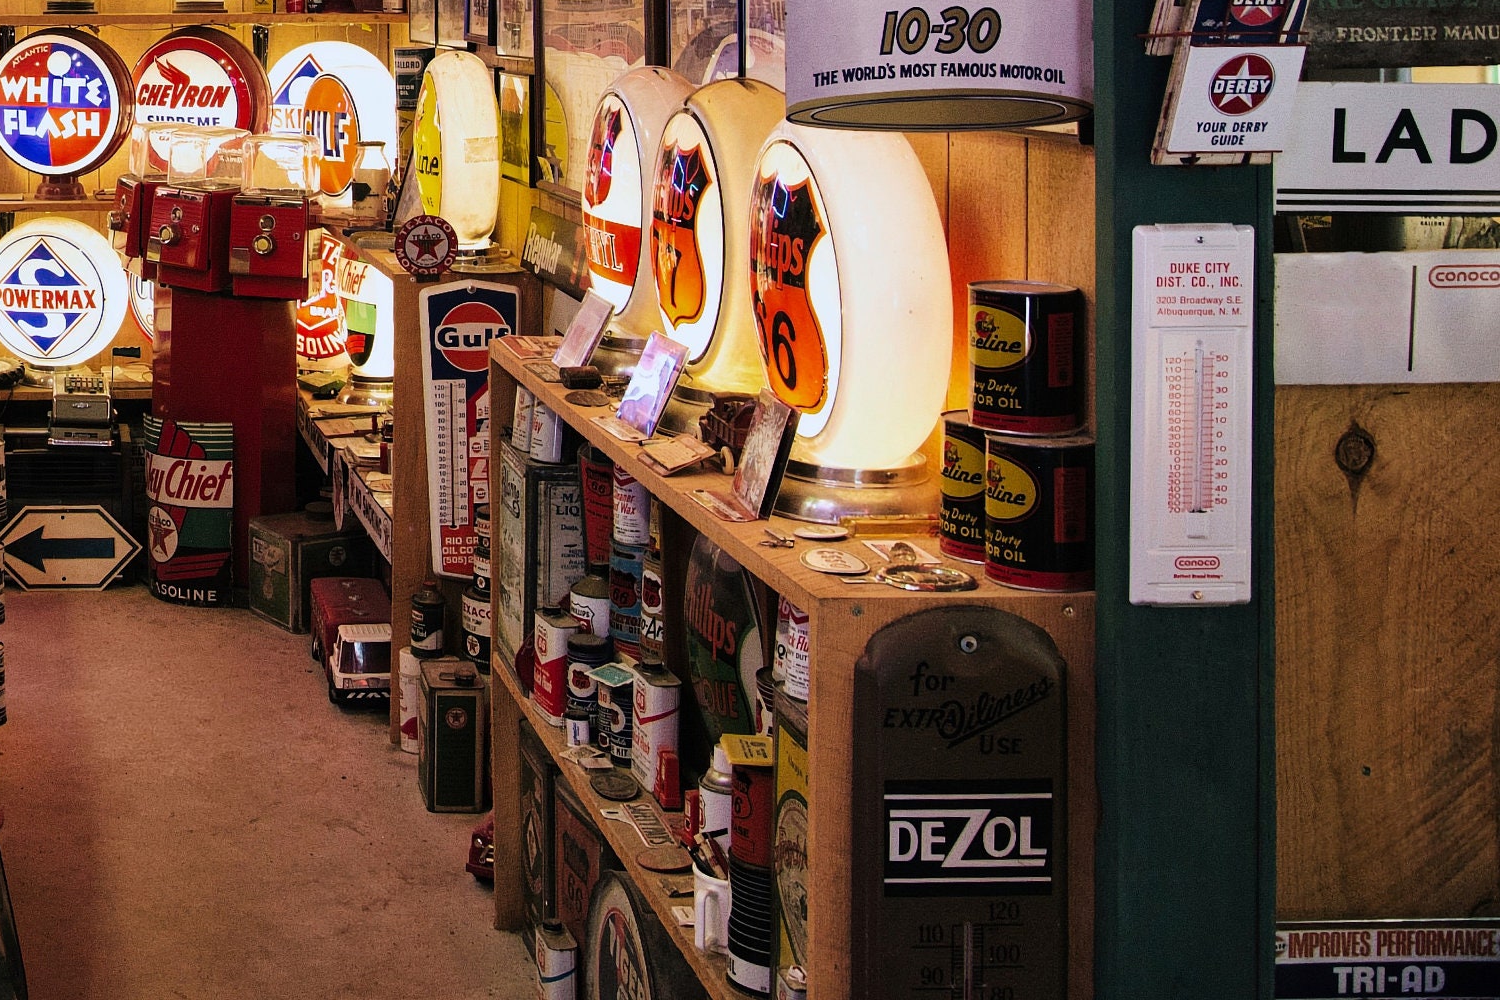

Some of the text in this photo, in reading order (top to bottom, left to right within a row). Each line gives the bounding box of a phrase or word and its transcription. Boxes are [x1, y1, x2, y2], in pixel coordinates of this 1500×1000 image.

[880, 6, 1001, 55] 10-30
[1336, 26, 1437, 43] FRONTIER
[12, 45, 49, 68] ATLANTIC
[813, 62, 1066, 87] THE WORLD'S MOST FAMOUS MOTOR OIL
[0, 74, 103, 107] WHITE
[137, 80, 231, 109] CHEVRON
[1213, 77, 1271, 94] DERBY
[4, 108, 100, 139] FLASH
[1196, 121, 1268, 133] YOUR DERBY
[1211, 134, 1244, 146] GUIDE
[400, 214, 451, 236] TEXACO
[1170, 263, 1230, 274] DUKE CITY
[1156, 276, 1243, 289] DIST. CO., INC.
[1156, 296, 1243, 307] 3203 Broadway S.E.
[437, 325, 510, 348] Gulf
[998, 396, 1022, 409] OIL
[164, 459, 233, 501] Chief
[960, 524, 983, 540] OIL
[1003, 548, 1027, 564] OIL
[1179, 558, 1217, 568] conoco
[909, 660, 955, 697] for
[980, 736, 1022, 755] USE
[889, 809, 1048, 868] DEZOL
[988, 903, 1020, 920] 120
[1289, 930, 1497, 958] IMPROVES PERFORMANCE
[989, 946, 1020, 962] 100
[1333, 965, 1446, 994] TRI-AD
